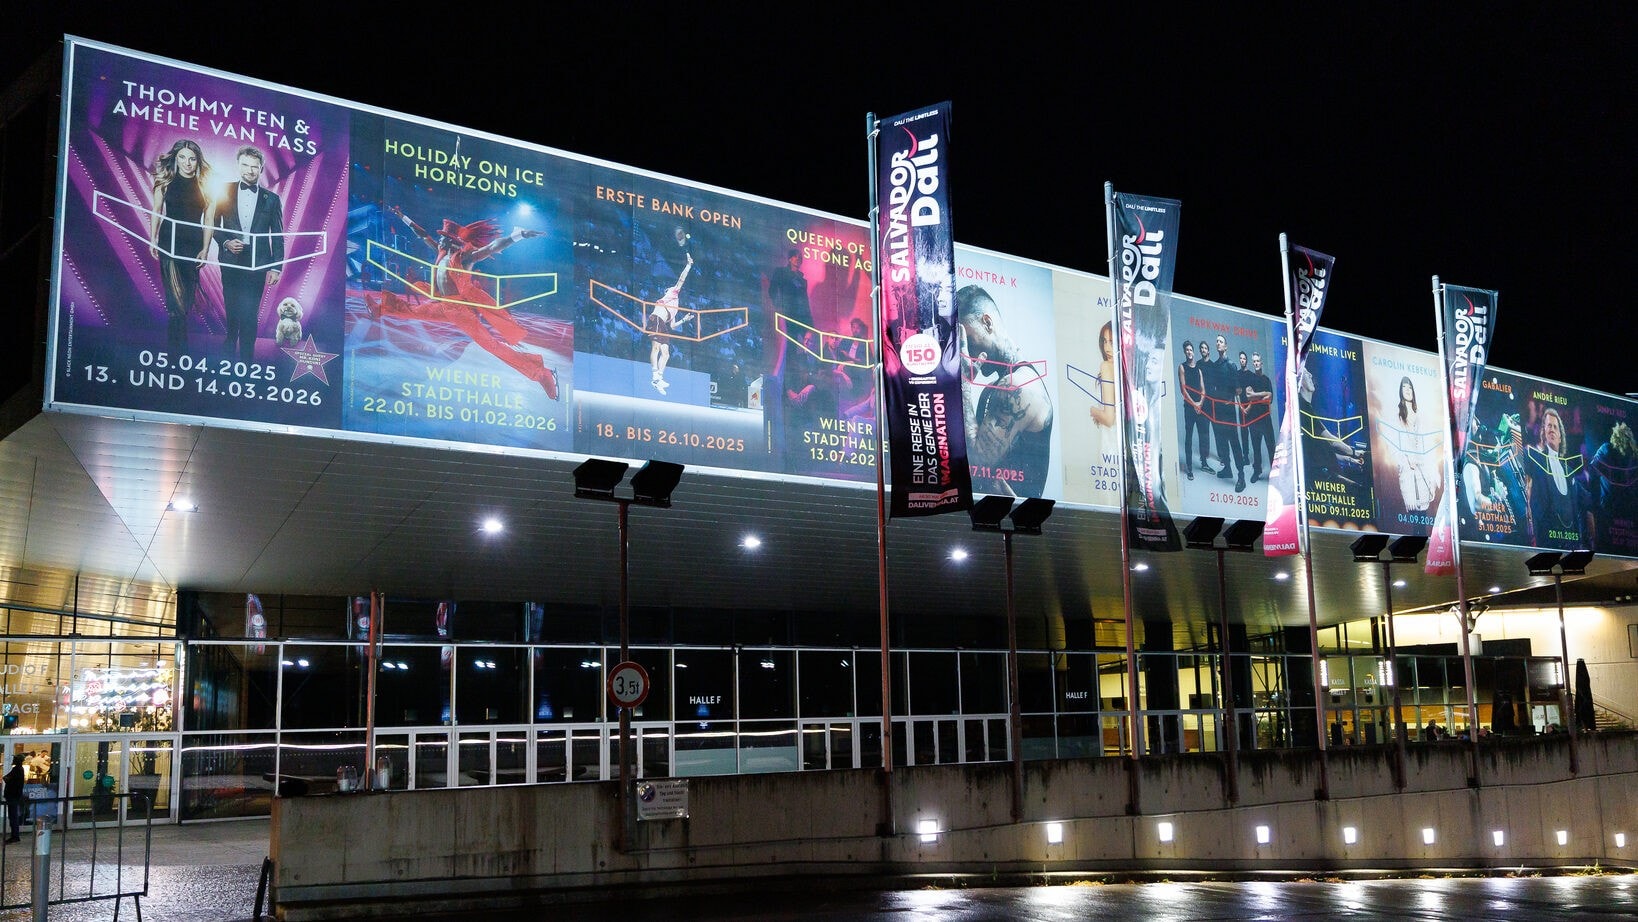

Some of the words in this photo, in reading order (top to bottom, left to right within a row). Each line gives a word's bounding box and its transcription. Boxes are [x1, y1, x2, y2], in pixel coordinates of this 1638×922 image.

[122, 80, 233, 118] THOMMY
[242, 108, 285, 130] TEN
[295, 119, 310, 136] &
[112, 99, 200, 131] AMÉLIE
[209, 119, 256, 143] VAN
[265, 131, 318, 156] TASS
[385, 138, 472, 170] HOLIDAY
[479, 160, 508, 179] ON
[515, 168, 544, 187] ICE
[414, 163, 518, 198] HORIZONS
[596, 185, 645, 209] ERSTE
[651, 198, 695, 219] BANK
[699, 209, 742, 230] OPEN
[889, 149, 914, 283] SALVADOR
[786, 228, 843, 251] QUEENS
[847, 242, 865, 256] OF
[803, 247, 849, 267] STONE
[854, 258, 872, 272] AG
[958, 266, 1006, 285] KONTRA
[1010, 277, 1017, 288] K
[1121, 234, 1139, 346] SALVADOR
[1189, 316, 1230, 333] PARKWAY
[1233, 325, 1258, 341] DRIVE
[906, 348, 936, 362] 150
[1308, 343, 1338, 358] IMMER
[1340, 347, 1357, 361] LIVE
[1454, 308, 1471, 399] SALVADOR
[138, 349, 277, 381] 05.04.2025
[1372, 356, 1405, 371] CAROLIN
[1408, 364, 1437, 378] KEBEKUS
[84, 364, 117, 385] 13.
[129, 369, 185, 392] UND
[195, 377, 323, 406] 14.03.2026
[425, 366, 502, 390] WIENER
[1482, 380, 1512, 394] GABALIER
[401, 382, 524, 411] STADTHALLE
[918, 392, 931, 418] DER
[1533, 391, 1553, 403] ANDRÉ
[1554, 395, 1568, 406] RIEU
[363, 397, 420, 417] 22.01.
[426, 405, 454, 421] BIS
[460, 407, 558, 432] 01.02.2026
[907, 403, 919, 416] IN
[596, 423, 620, 439] 18.
[626, 426, 652, 442] BIS
[658, 430, 745, 453] 26.10.2025
[820, 417, 873, 436] WIENER
[909, 417, 923, 452] REISE
[922, 419, 937, 455] GENIE
[803, 431, 889, 453] STADTHALE
[932, 393, 950, 486] IMAGINATION
[810, 447, 875, 466] 13.07.202
[912, 454, 924, 484] EINE
[927, 458, 938, 485] DAS
[1306, 491, 1356, 506] STADTHALLE
[1314, 480, 1346, 494] WIENER
[1209, 492, 1259, 507] 21.09.2025
[1308, 503, 1327, 514] UND
[1330, 506, 1370, 519] 09.11.2025
[1481, 502, 1506, 513] WIENER
[1398, 513, 1434, 526] 04.09.202
[1474, 511, 1514, 525] STADTHALLE
[1478, 524, 1512, 535] 31.10.2025
[1549, 528, 1579, 541] 20.11.2025
[615, 676, 639, 696] 3,5t
[1065, 691, 1083, 699] HALLE
[1084, 691, 1088, 699] F
[689, 695, 715, 704] HALLE
[716, 695, 721, 704] F
